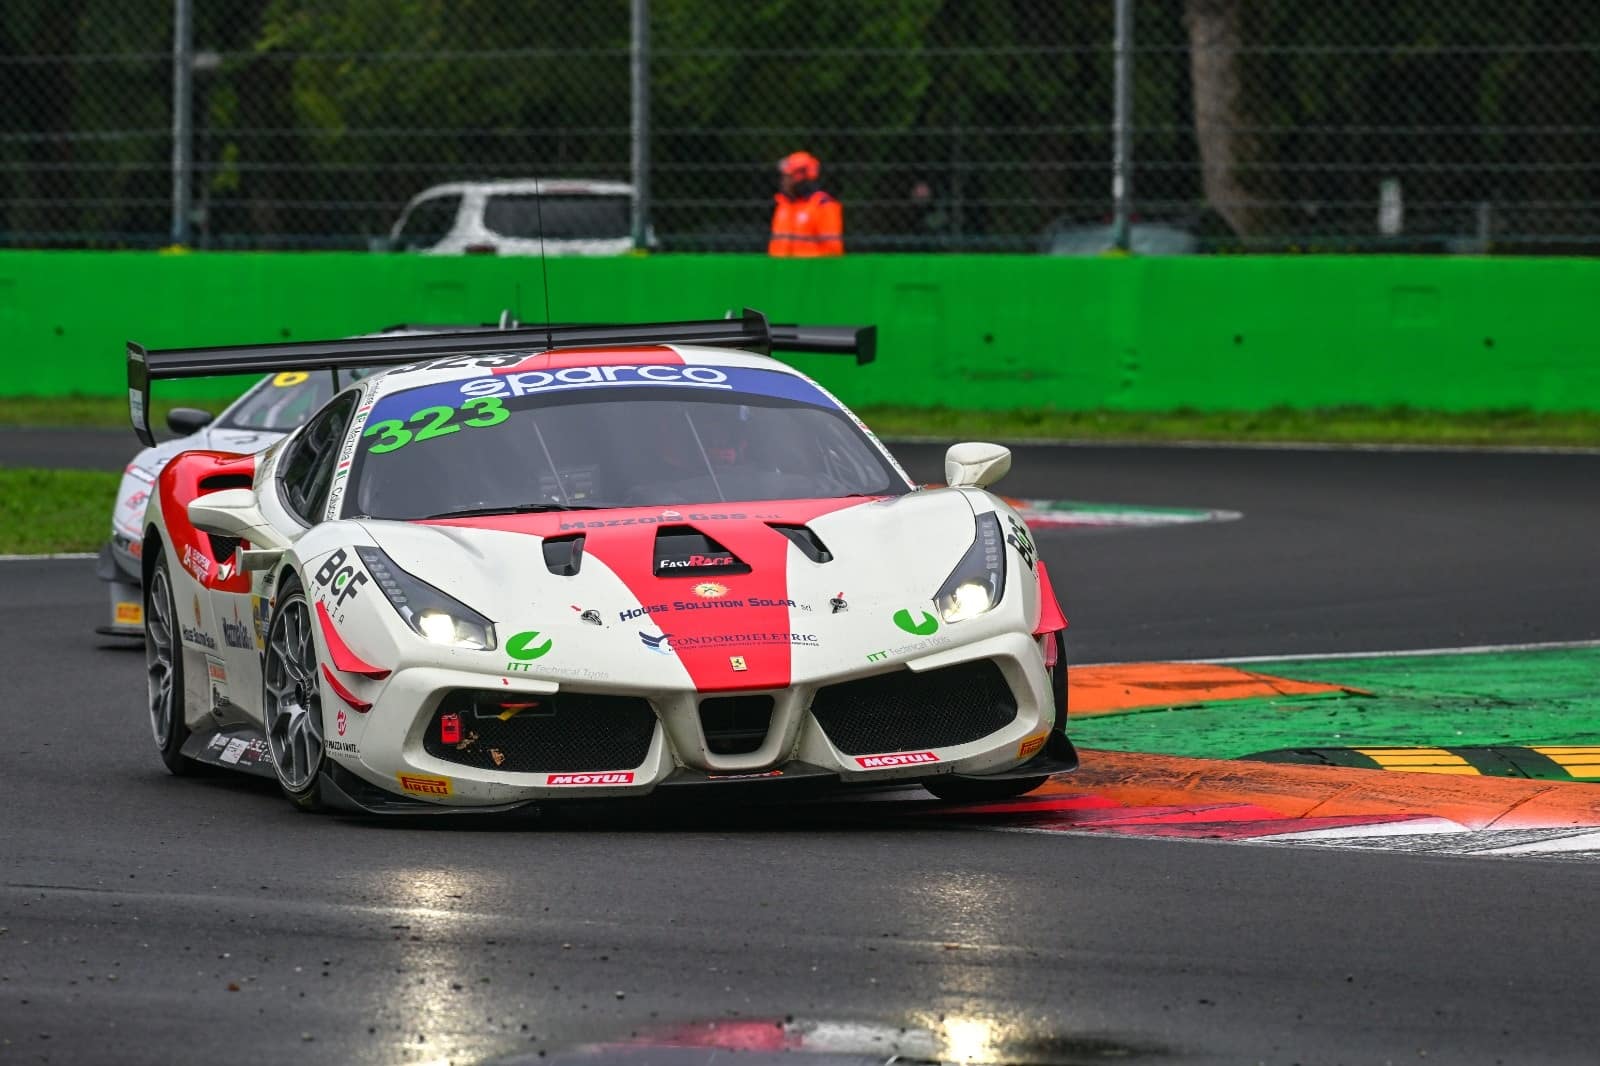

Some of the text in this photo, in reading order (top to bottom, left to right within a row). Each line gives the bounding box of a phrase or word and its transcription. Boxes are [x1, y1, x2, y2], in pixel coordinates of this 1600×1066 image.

[460, 365, 731, 398] sparco
[363, 396, 511, 454] 323
[315, 548, 368, 607] BCF
[619, 604, 669, 622] HOUSE
[673, 600, 743, 612] SOLUTION
[748, 597, 797, 608] SOLAR
[866, 650, 888, 662] ITT
[507, 662, 533, 671] ITT
[863, 754, 935, 767] MOTUL
[401, 776, 449, 795] PIRELLI
[551, 774, 629, 784] MOTUL
